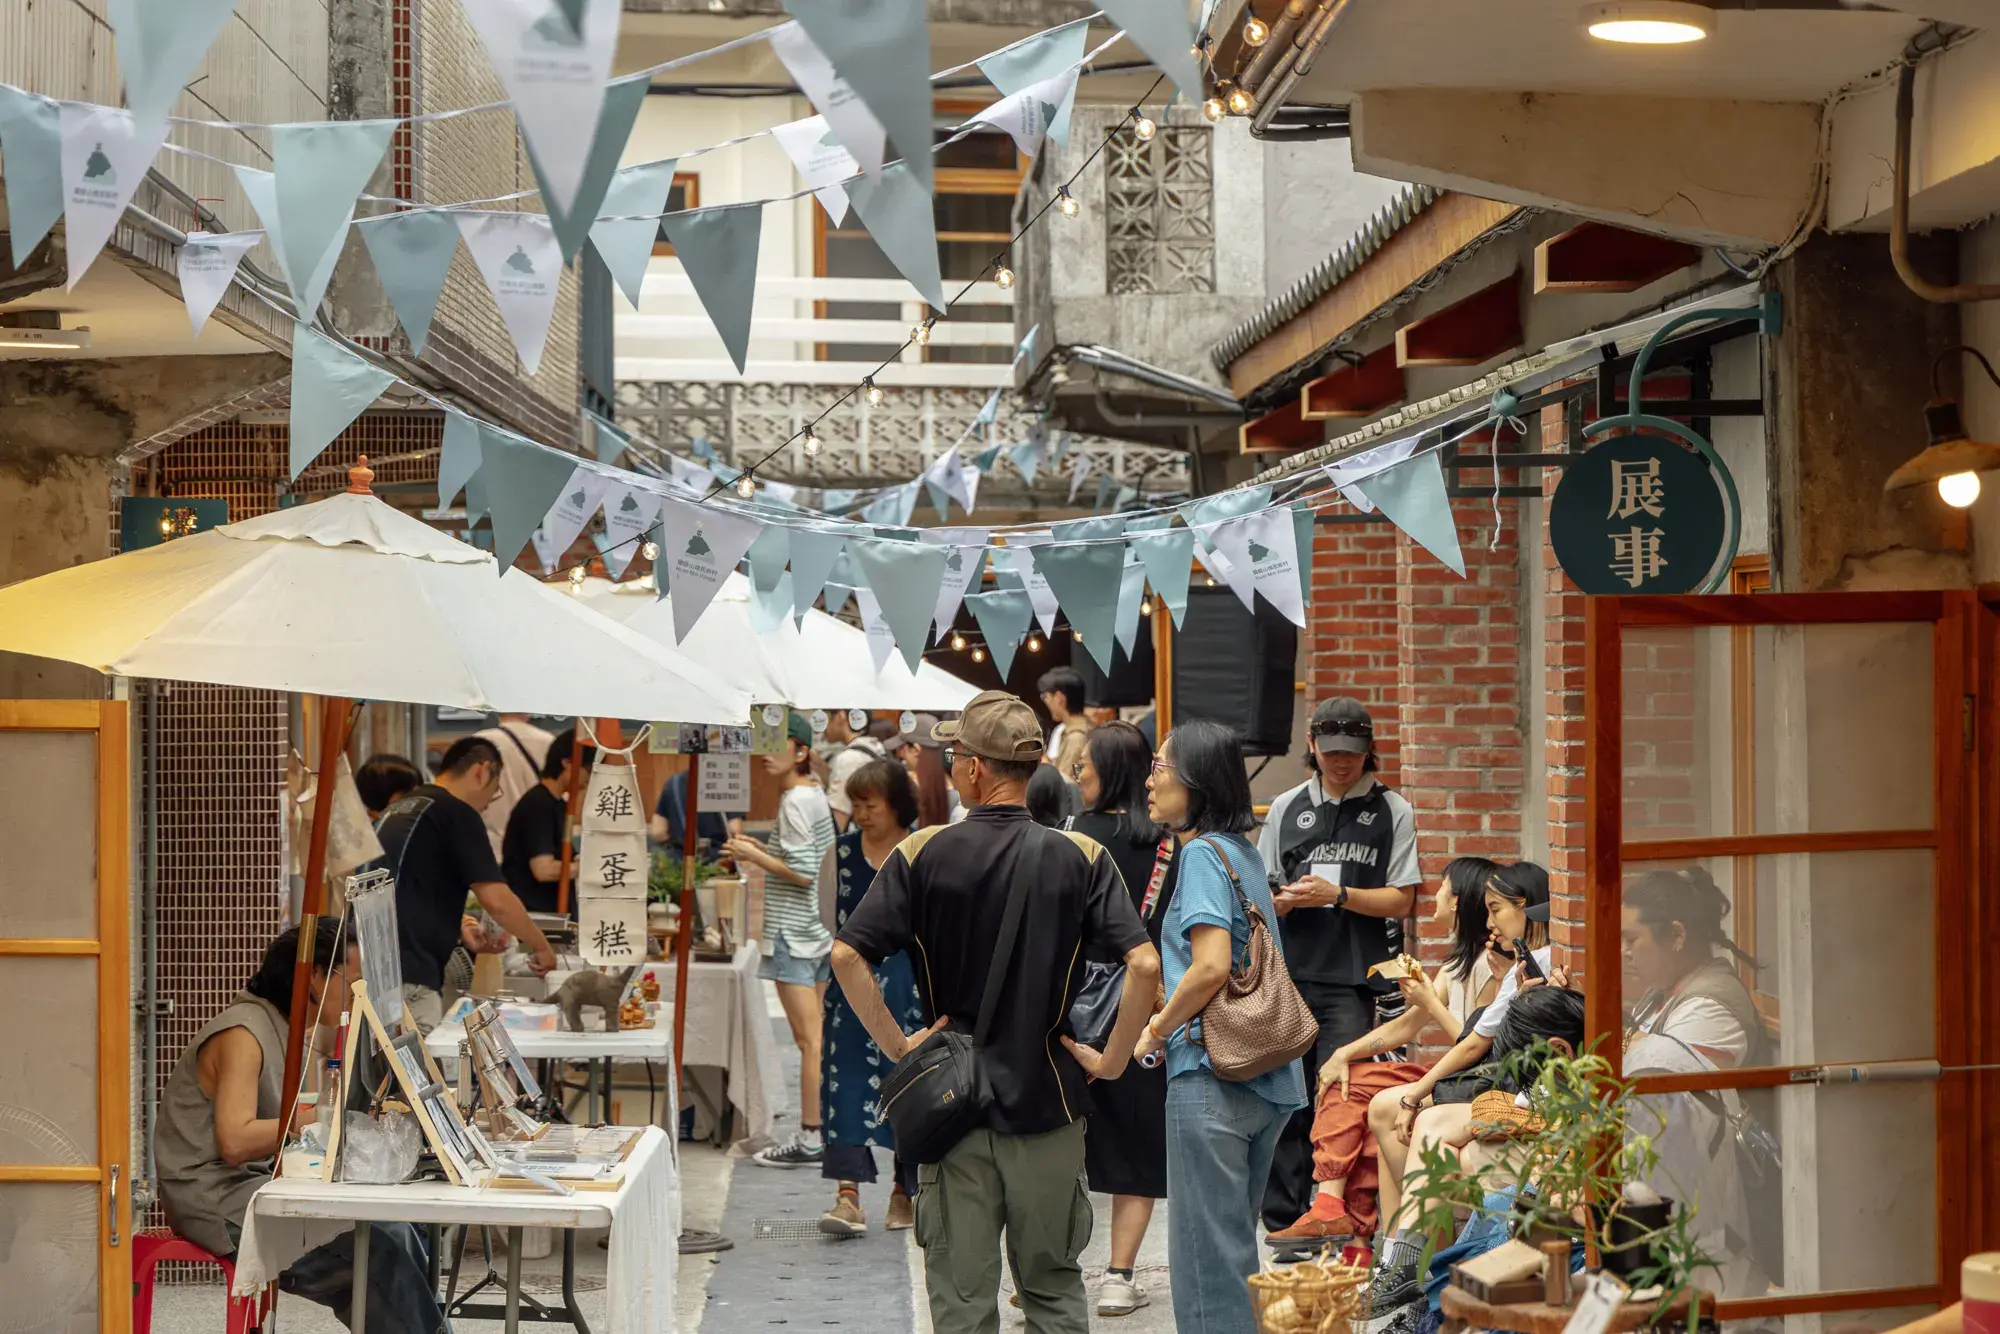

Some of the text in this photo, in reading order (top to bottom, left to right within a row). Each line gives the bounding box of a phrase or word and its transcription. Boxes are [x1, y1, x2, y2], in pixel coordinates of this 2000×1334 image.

[1606, 456, 1669, 588] 展事
[592, 785, 636, 957] 雞蛋糕
